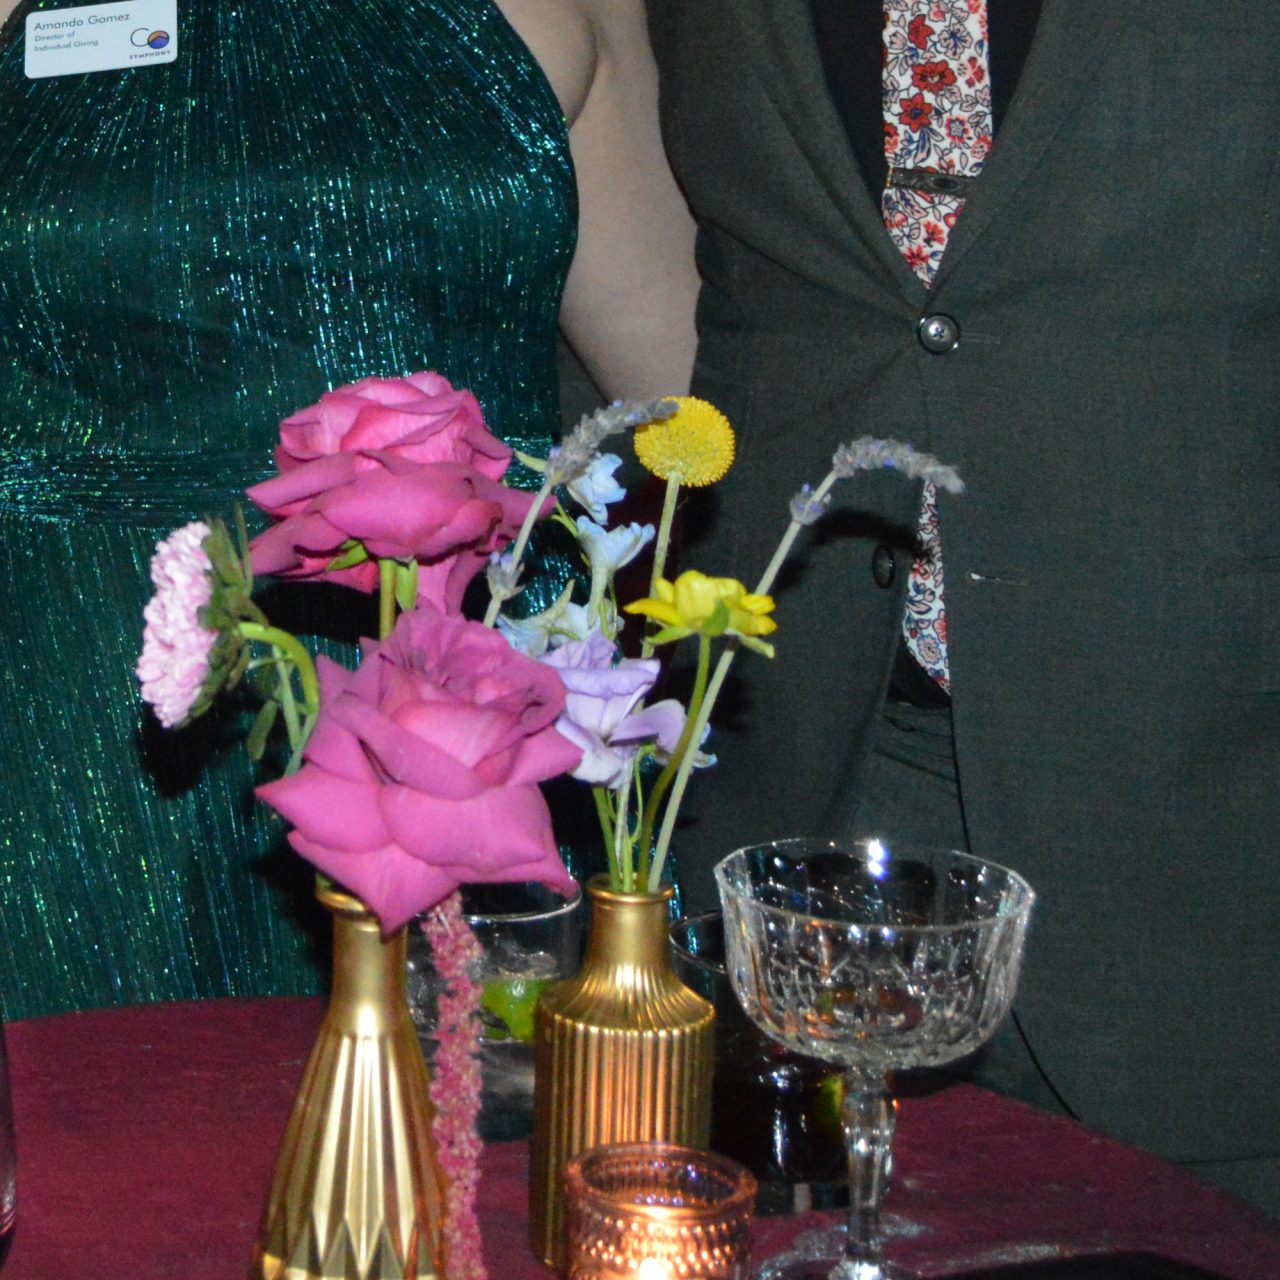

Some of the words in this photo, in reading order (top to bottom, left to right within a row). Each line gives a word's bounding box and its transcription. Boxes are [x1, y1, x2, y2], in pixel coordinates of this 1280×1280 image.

[34, 17, 84, 31] Amanda
[88, 13, 130, 25] Gomez
[34, 33, 65, 42] Director
[66, 31, 75, 39] of
[34, 41, 72, 52] Individual
[73, 39, 99, 48] Giving
[129, 50, 171, 60] SYMPHONY
